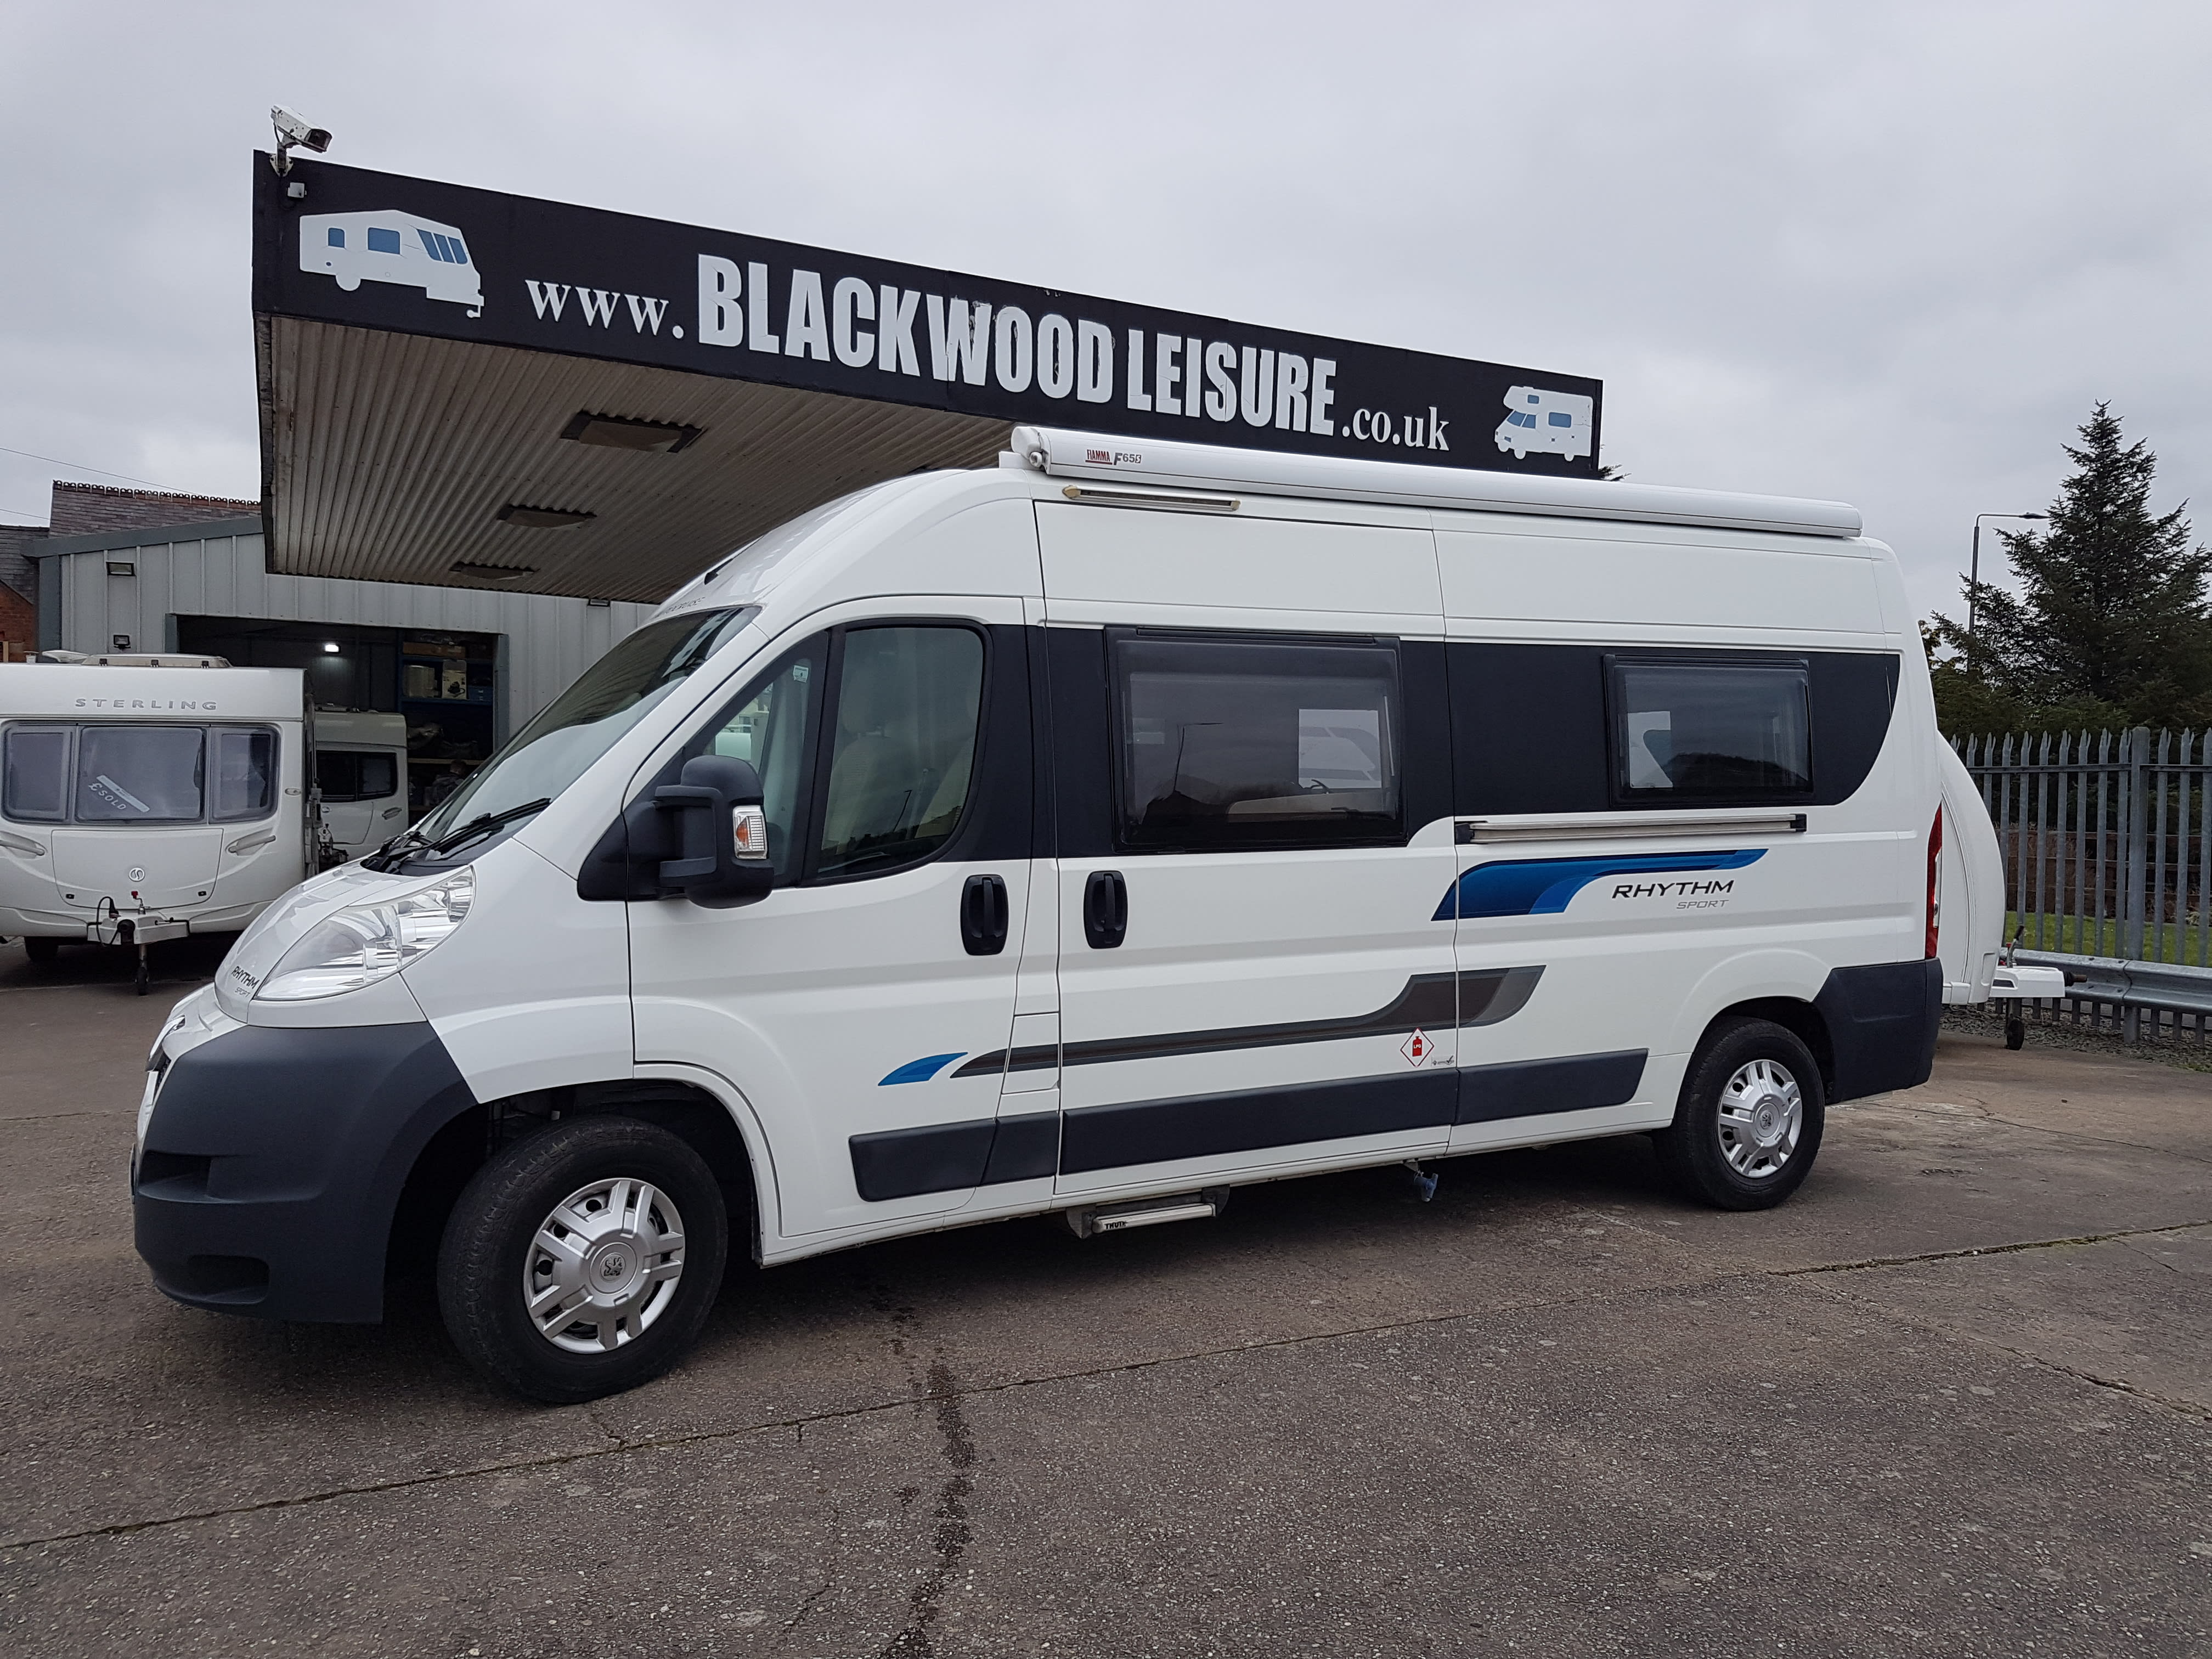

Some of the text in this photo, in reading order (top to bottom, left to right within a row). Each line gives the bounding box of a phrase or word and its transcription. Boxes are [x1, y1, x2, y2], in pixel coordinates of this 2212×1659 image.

[525, 253, 1449, 451] www. BLACKWOOD LEISURE .co.uk
[1086, 449, 1110, 462] FIAMMA
[75, 698, 216, 710] STERLING
[1612, 880, 1734, 899] RHYTHM
[1676, 900, 1729, 909] SPORT
[231, 966, 260, 989] RHYTHM
